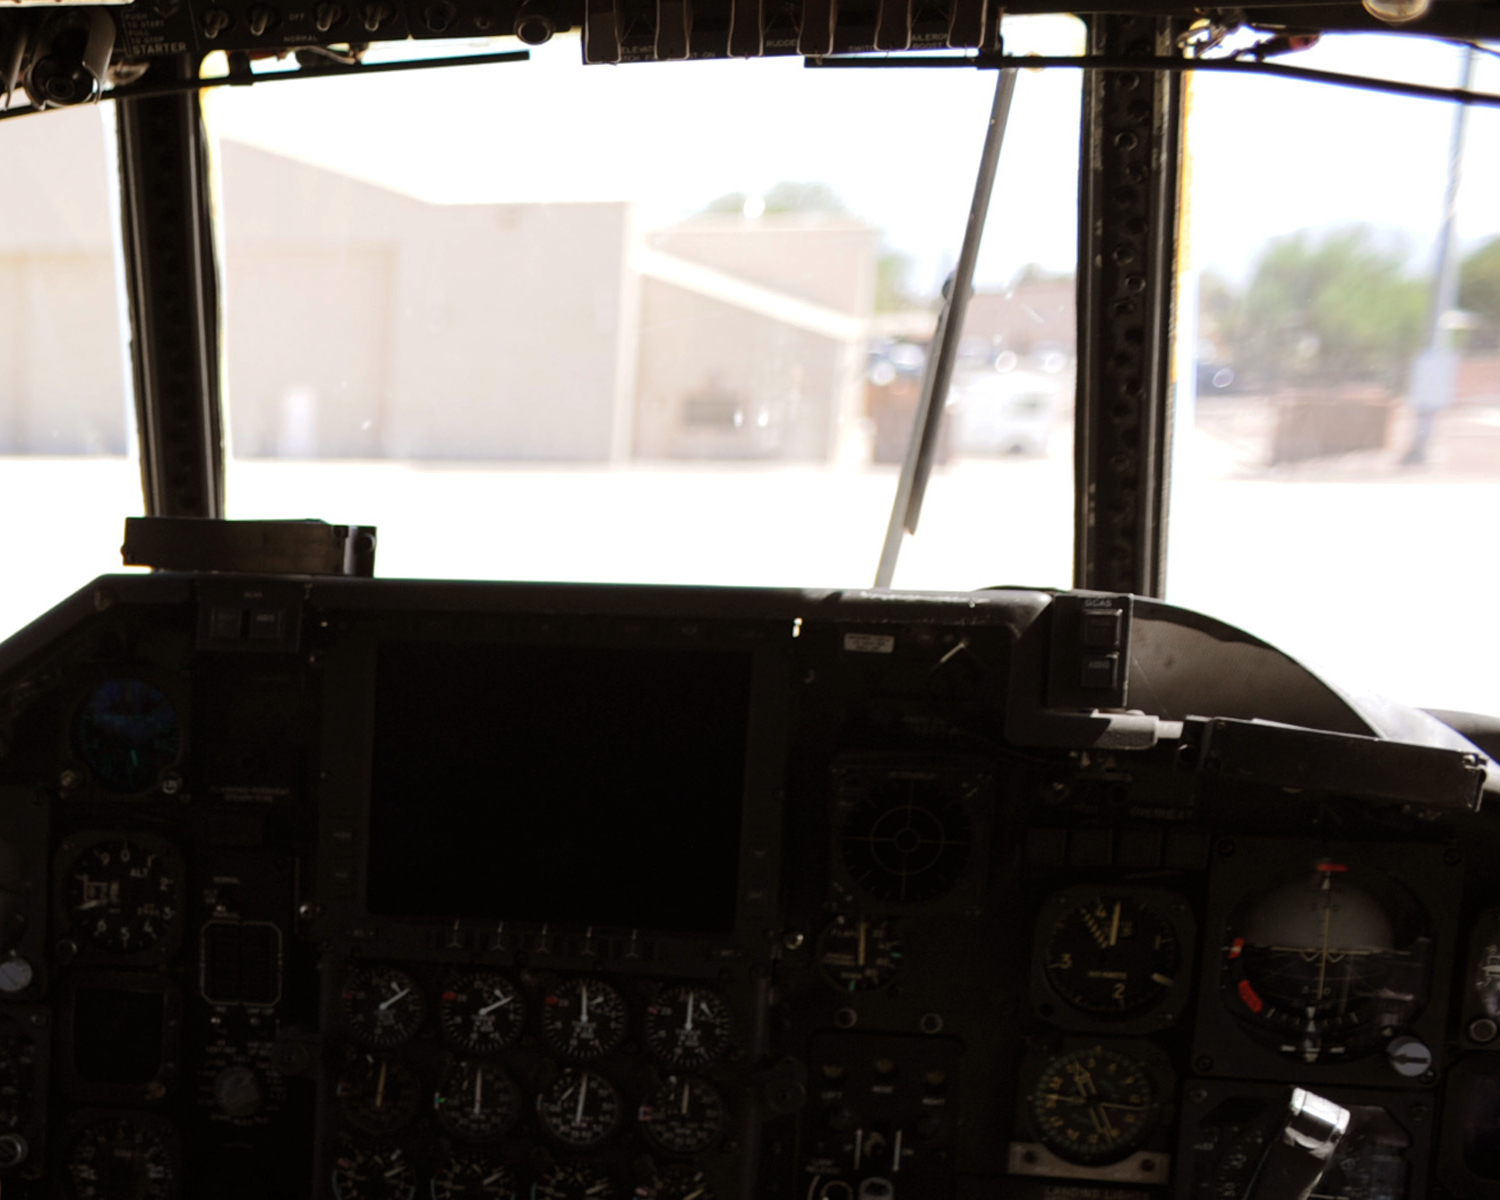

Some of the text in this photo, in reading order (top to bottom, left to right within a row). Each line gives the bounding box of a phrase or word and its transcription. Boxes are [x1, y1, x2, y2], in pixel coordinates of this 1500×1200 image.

[132, 41, 187, 56] STARTER
[766, 39, 798, 48] RUDDE
[1112, 981, 1126, 1000] 2
